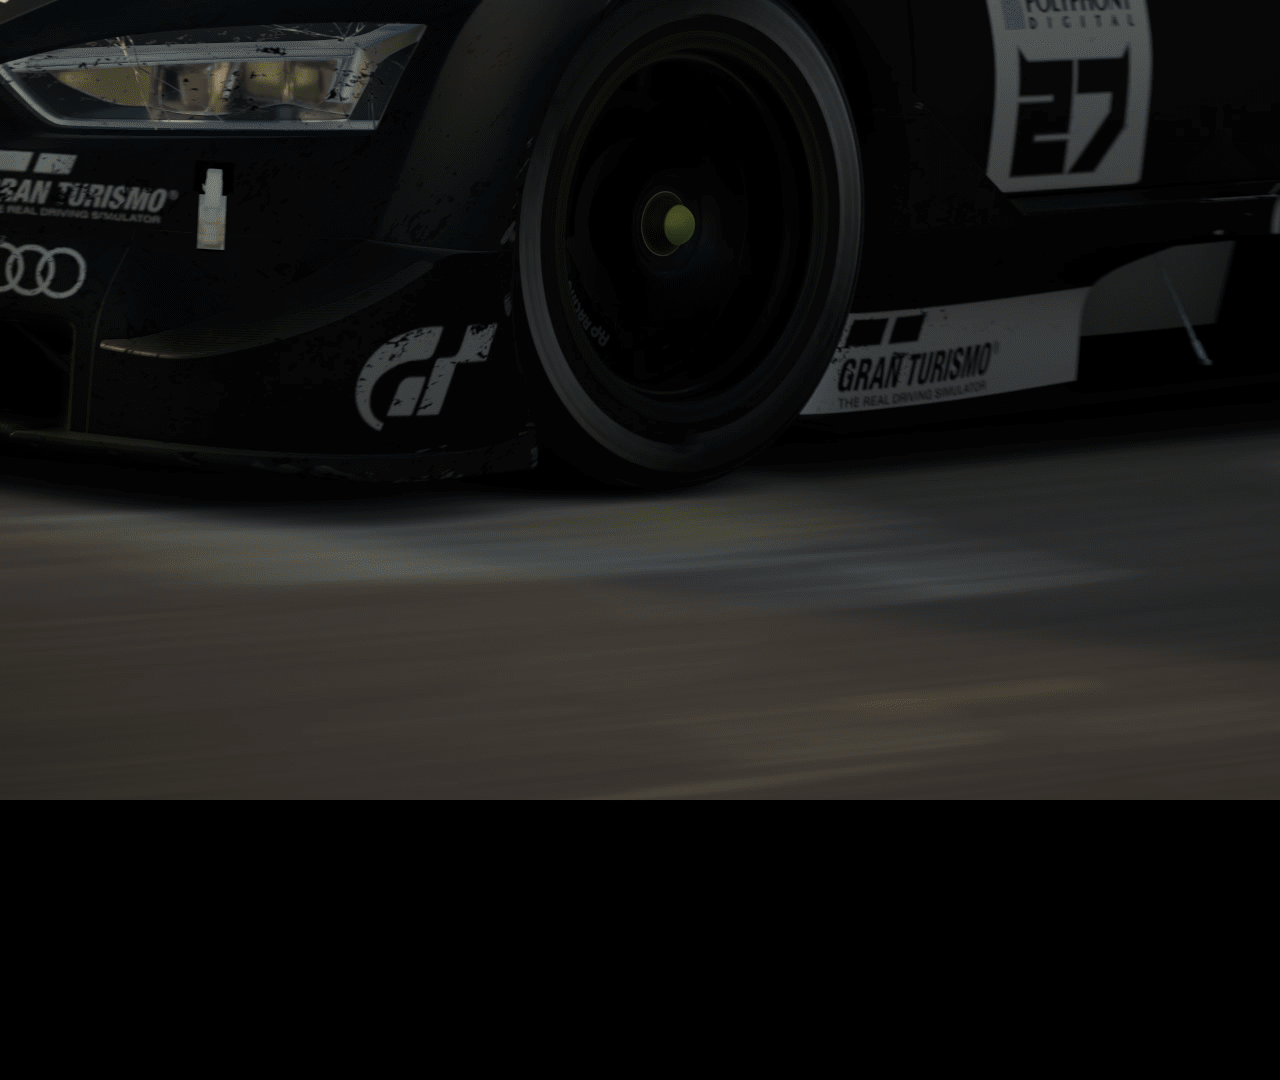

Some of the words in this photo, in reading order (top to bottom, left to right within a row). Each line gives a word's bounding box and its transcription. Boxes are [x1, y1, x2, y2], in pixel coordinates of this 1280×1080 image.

[1028, 14, 1136, 30] DIGITAL
[1009, 42, 1131, 178] 27
[6, 204, 38, 216] REAL
[39, 206, 90, 220] DRIVING
[56, 180, 169, 214] TURISMO
[837, 354, 904, 392] GRAN
[907, 342, 992, 386] TURISMO
[837, 396, 859, 410] THE
[862, 393, 890, 408] REAL
[891, 389, 933, 405] DRIVING
[934, 380, 988, 400] SIMULATOR
